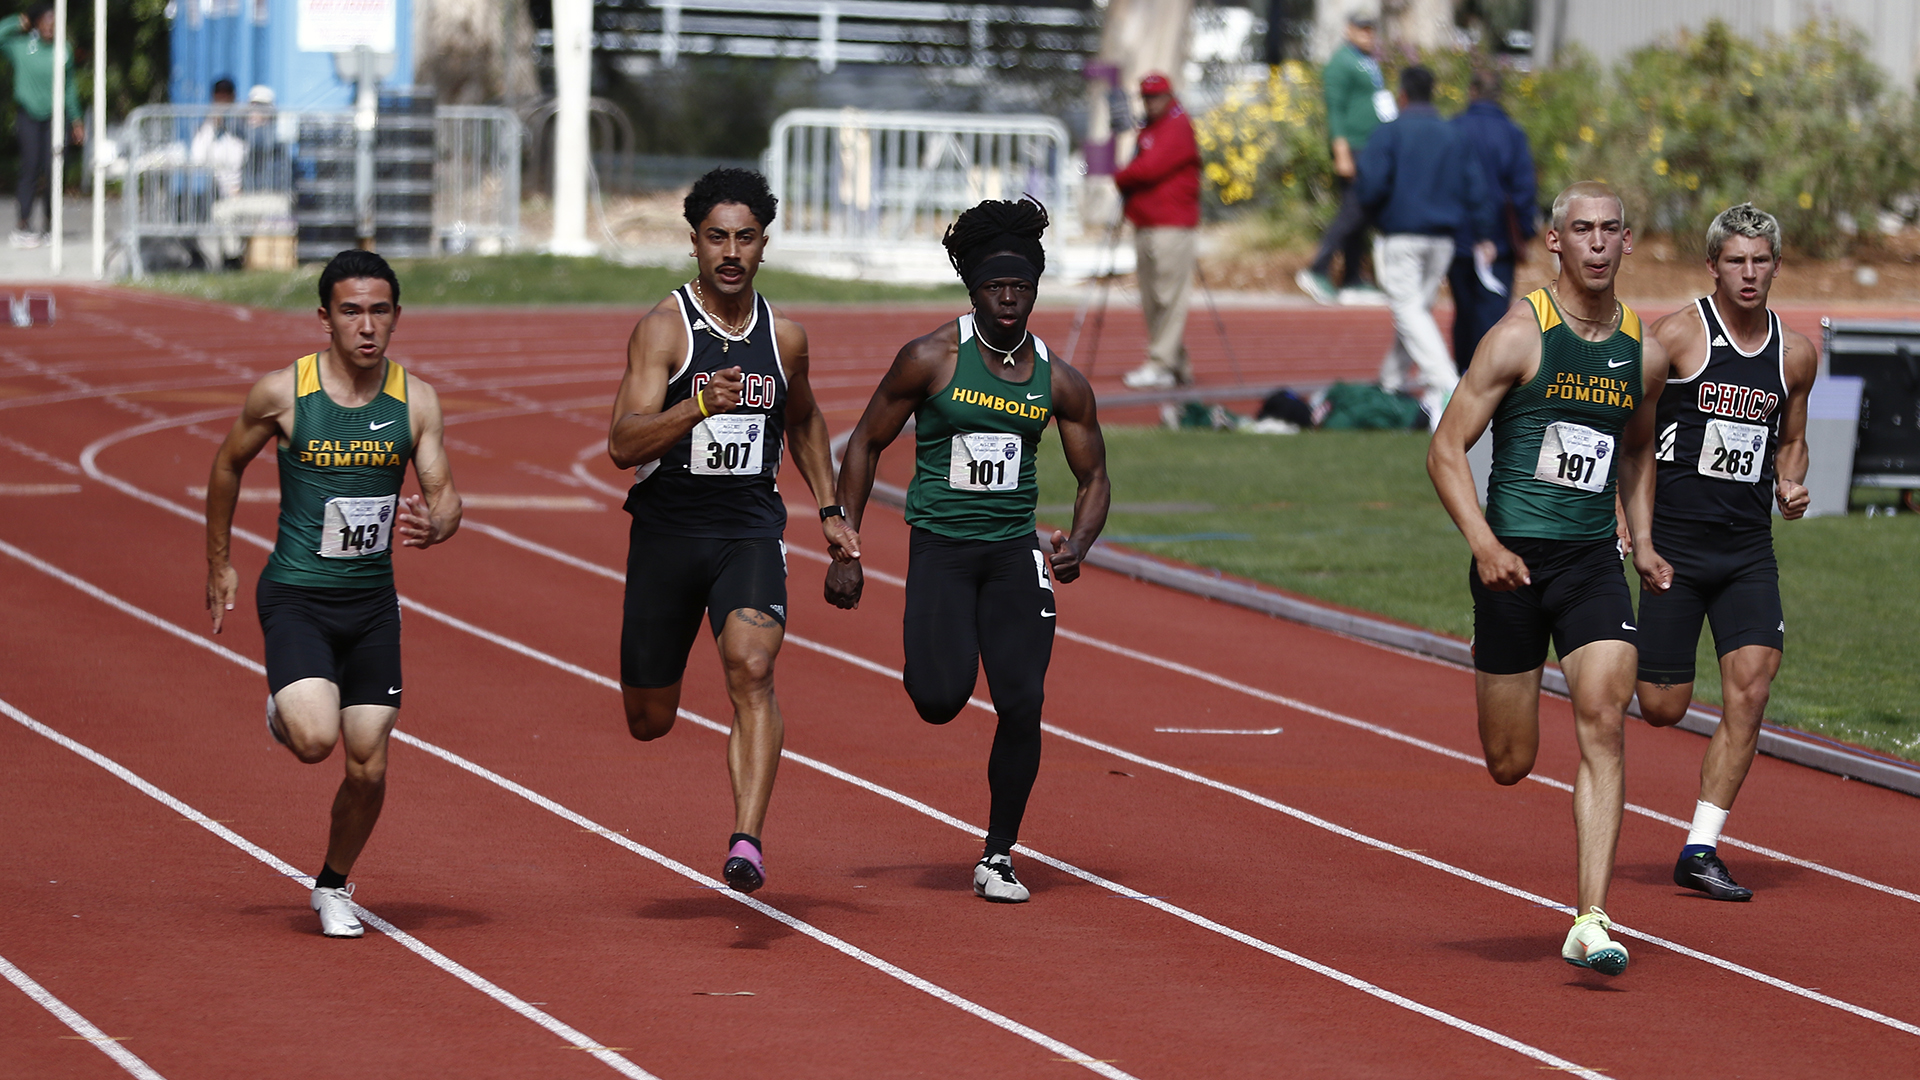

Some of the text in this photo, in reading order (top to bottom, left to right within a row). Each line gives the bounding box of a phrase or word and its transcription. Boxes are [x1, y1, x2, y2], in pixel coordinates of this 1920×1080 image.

[691, 372, 776, 409] CCO
[1556, 372, 1628, 392] CAL POLY
[951, 387, 1048, 421] HUMBOLDT
[1545, 384, 1634, 410] POMONA
[1698, 381, 1779, 422] CHICO
[299, 451, 401, 466] POMONA
[308, 440, 394, 452] CAL POLY
[706, 442, 752, 469] 307
[967, 459, 1005, 486] 101
[1556, 452, 1596, 484] 197
[1711, 447, 1755, 476] 283
[339, 523, 380, 551] 143
